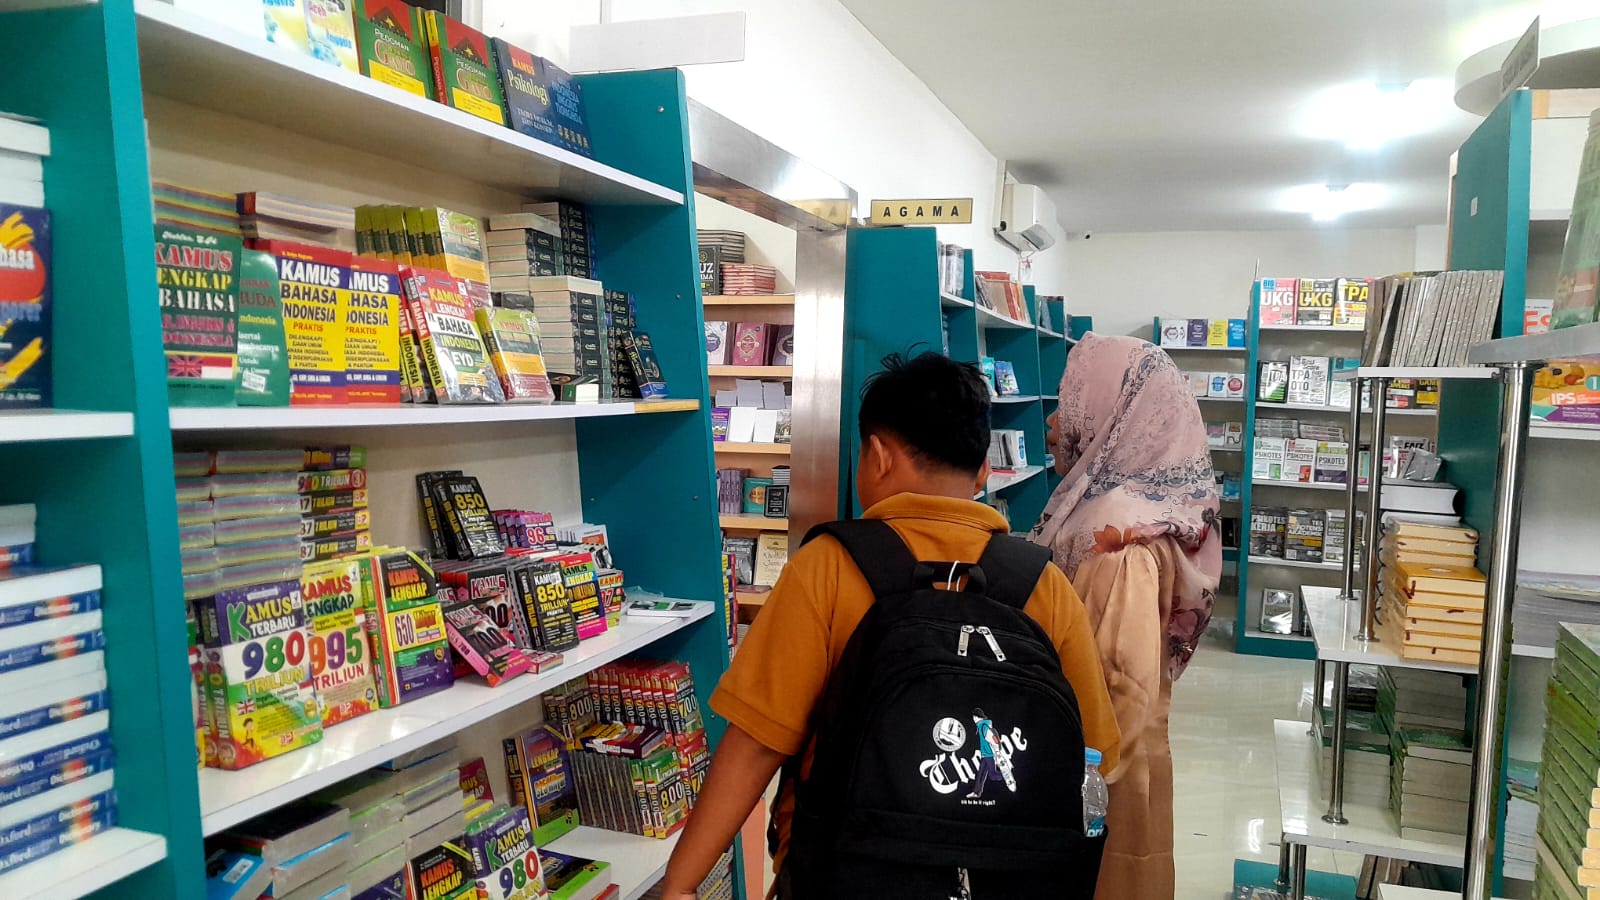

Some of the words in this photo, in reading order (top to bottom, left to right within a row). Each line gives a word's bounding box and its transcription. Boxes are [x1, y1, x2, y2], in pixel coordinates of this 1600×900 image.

[374, 28, 409, 52] PEDOMAN
[507, 69, 549, 106] Psikologi
[883, 205, 959, 218] AGAMA
[157, 268, 232, 290] ENGKAP
[281, 258, 341, 288] KAMUS
[699, 262, 714, 274] UZ
[159, 288, 235, 313] BAHASA
[281, 283, 338, 306] BAHASA
[347, 292, 388, 310] HASA
[428, 286, 466, 307] KAMUS
[1261, 291, 1293, 306] UKG
[1299, 292, 1333, 307] UKG
[239, 314, 277, 326] ndonesia
[283, 302, 336, 323] NDONESIA
[346, 309, 389, 326] ONESIA
[293, 322, 324, 333] PRAKTIS
[439, 316, 475, 337] BAHASA
[411, 301, 429, 337] BAHASA
[422, 338, 443, 386] INDONESIA
[402, 336, 420, 385] INDONESIA
[451, 351, 475, 367] EYD
[1591, 376, 1597, 389] 1
[1551, 392, 1577, 405] IPS
[1254, 451, 1282, 459] PSIKOTES
[1318, 456, 1346, 465] PSIKOTES
[454, 492, 486, 510] 850
[526, 527, 546, 545] 96
[1250, 523, 1276, 532] KERJA
[388, 567, 420, 586] KAMUS
[533, 571, 563, 586] KAMUS
[565, 571, 594, 586] ENGKAP
[301, 575, 353, 602] KAMUS
[390, 582, 428, 602] LENGKAP
[536, 582, 566, 604] 850
[305, 594, 354, 618] ENGKAP
[226, 595, 293, 643] KAMUS
[250, 615, 296, 638] TERBARU
[394, 613, 415, 647] 650
[242, 630, 305, 681] 980
[308, 627, 363, 677] 995
[243, 667, 305, 697] TRILIUN
[313, 663, 365, 691] TRILIUN
[569, 696, 592, 721] 800
[677, 693, 698, 718] 700
[0, 786, 21, 802] ford
[660, 781, 683, 809] 800
[0, 823, 32, 845] xford
[0, 846, 33, 870] xford
[484, 826, 526, 874] KAMUS
[500, 838, 529, 864] TERBARU
[420, 859, 455, 889] KAMUS
[423, 870, 463, 900] LENGKAP
[498, 850, 540, 899] 980
